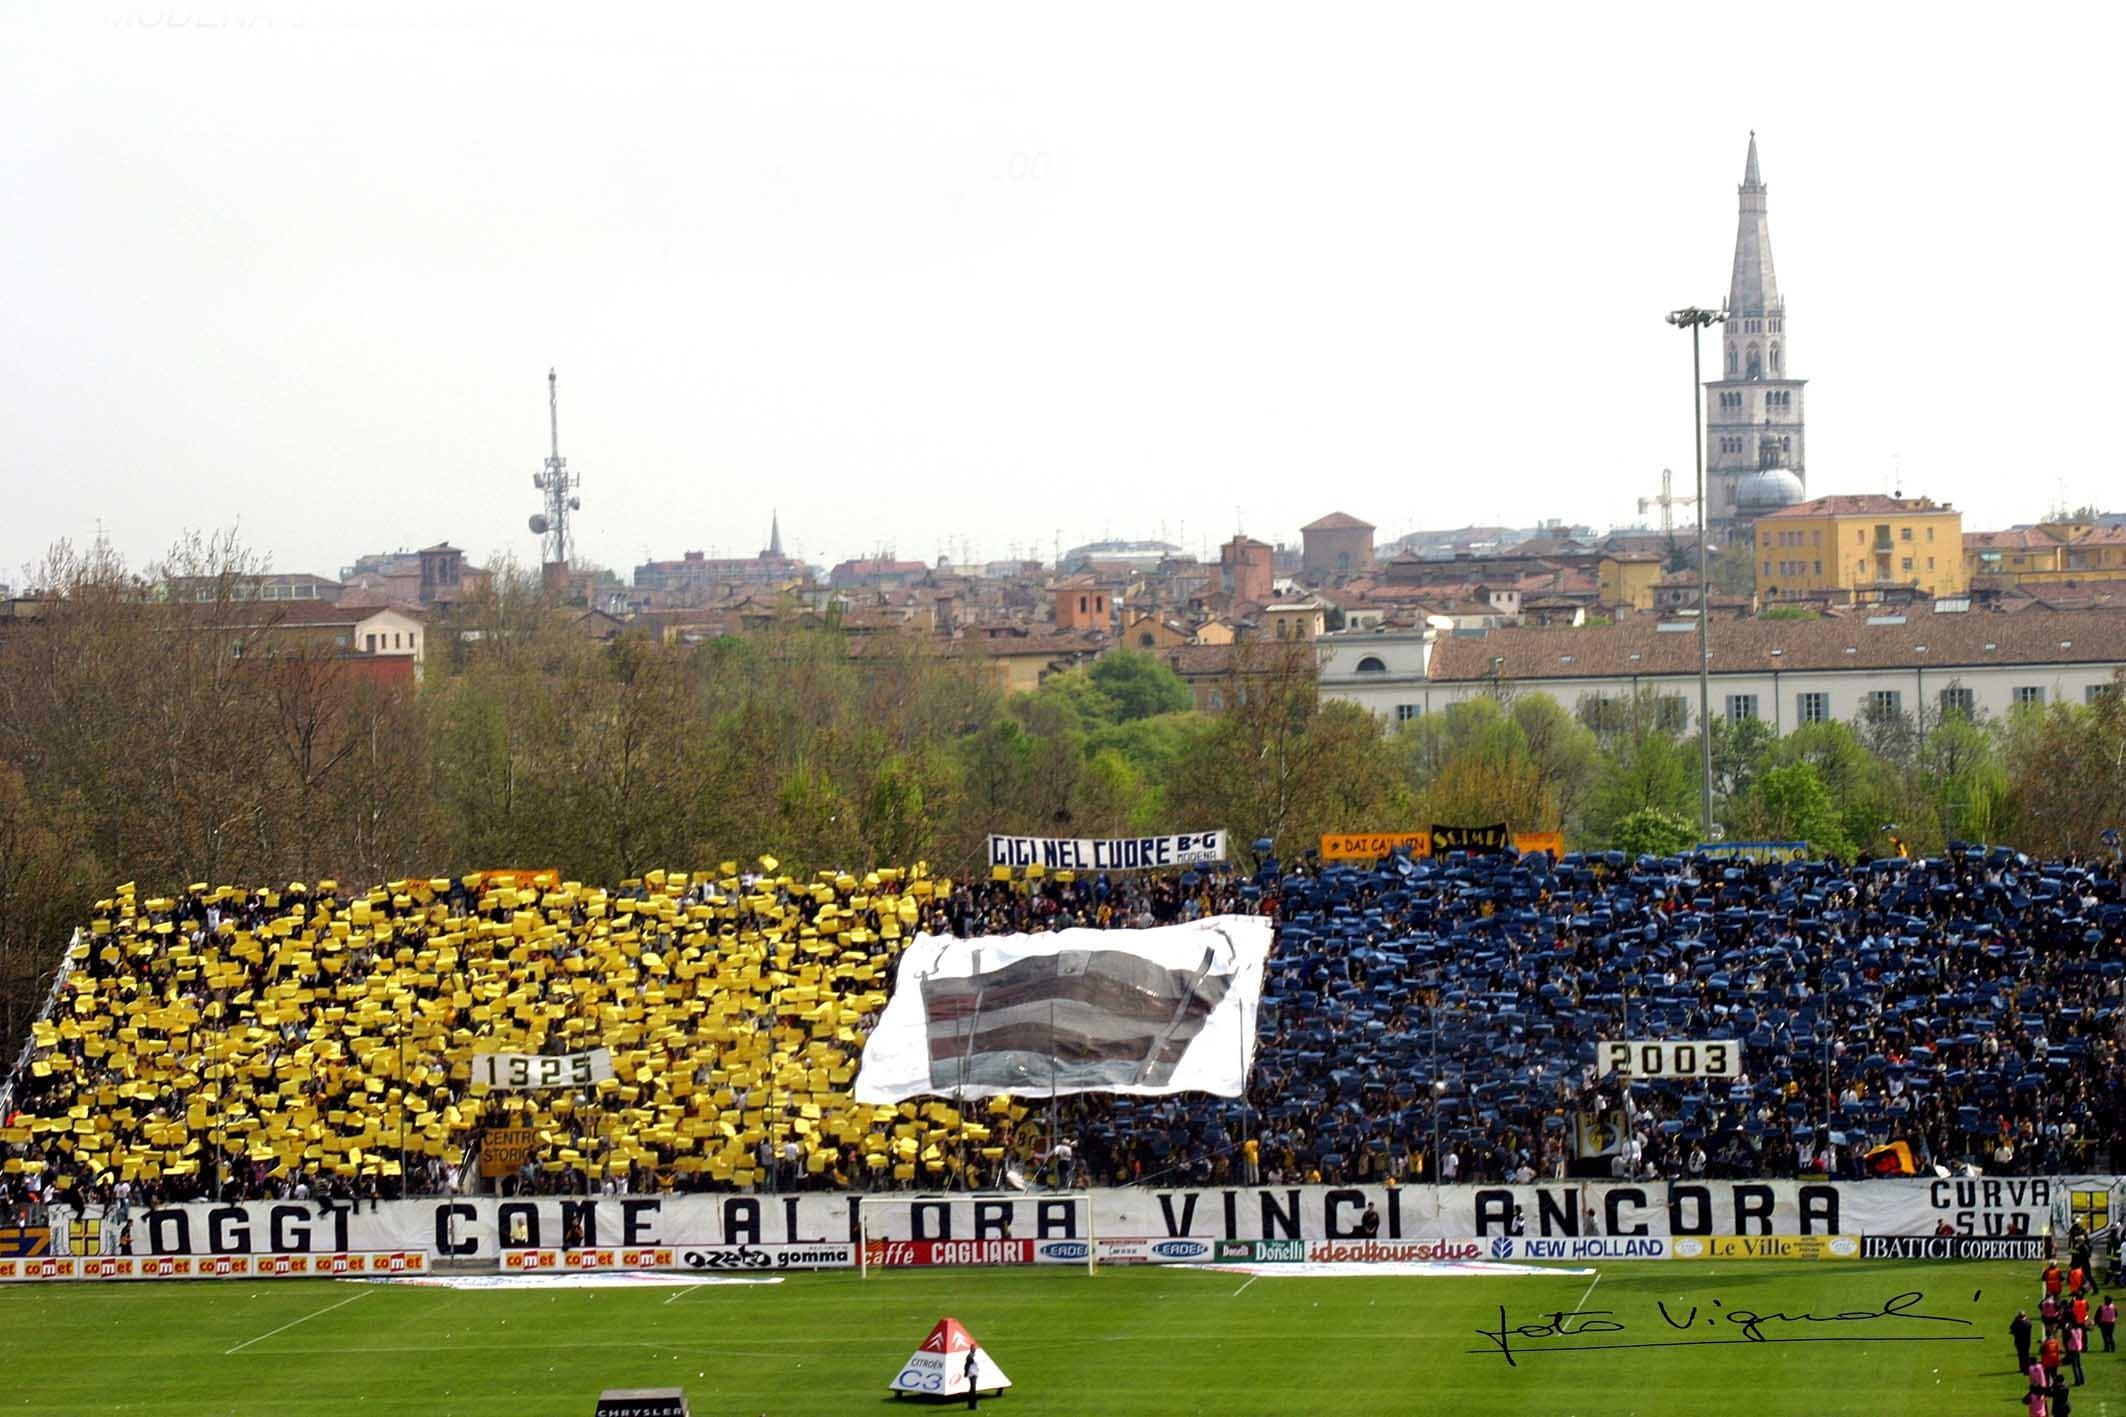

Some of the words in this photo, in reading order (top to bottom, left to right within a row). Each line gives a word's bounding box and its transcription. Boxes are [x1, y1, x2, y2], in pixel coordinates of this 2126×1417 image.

[1043, 839, 1088, 868] NEL
[1092, 837, 1170, 869] CUORE
[1610, 1044, 1727, 1075] 2003
[486, 1055, 592, 1087] 1325
[1930, 1179, 2050, 1209] CURVA
[145, 1205, 351, 1254] OGGI
[435, 1200, 662, 1255] COME
[1157, 1189, 1402, 1239] VINCI
[1475, 1184, 1840, 1237] ANCORA
[1956, 1211, 2030, 1237] SUD
[930, 1241, 1024, 1264] CAGLIARI
[1255, 1240, 1304, 1261] Donelli
[1525, 1240, 1569, 1257] NEW
[1573, 1239, 1665, 1257] HOLLAND
[1709, 1239, 1736, 1257] Le
[1743, 1238, 1792, 1256] Ville
[1864, 1238, 1952, 1259] IBATICI
[25, 1258, 72, 1278] comet
[84, 1258, 132, 1278] comet
[142, 1257, 190, 1277] comet
[200, 1255, 247, 1276] comet
[258, 1254, 306, 1275] comet
[316, 1252, 364, 1275] comet
[374, 1252, 421, 1273] comet
[506, 1250, 555, 1271] comet
[565, 1250, 614, 1270] comet
[623, 1250, 672, 1269] comet
[777, 1251, 848, 1268] gomma
[898, 1369, 944, 1391] C3
[597, 1407, 682, 1417] CHRYSLER
